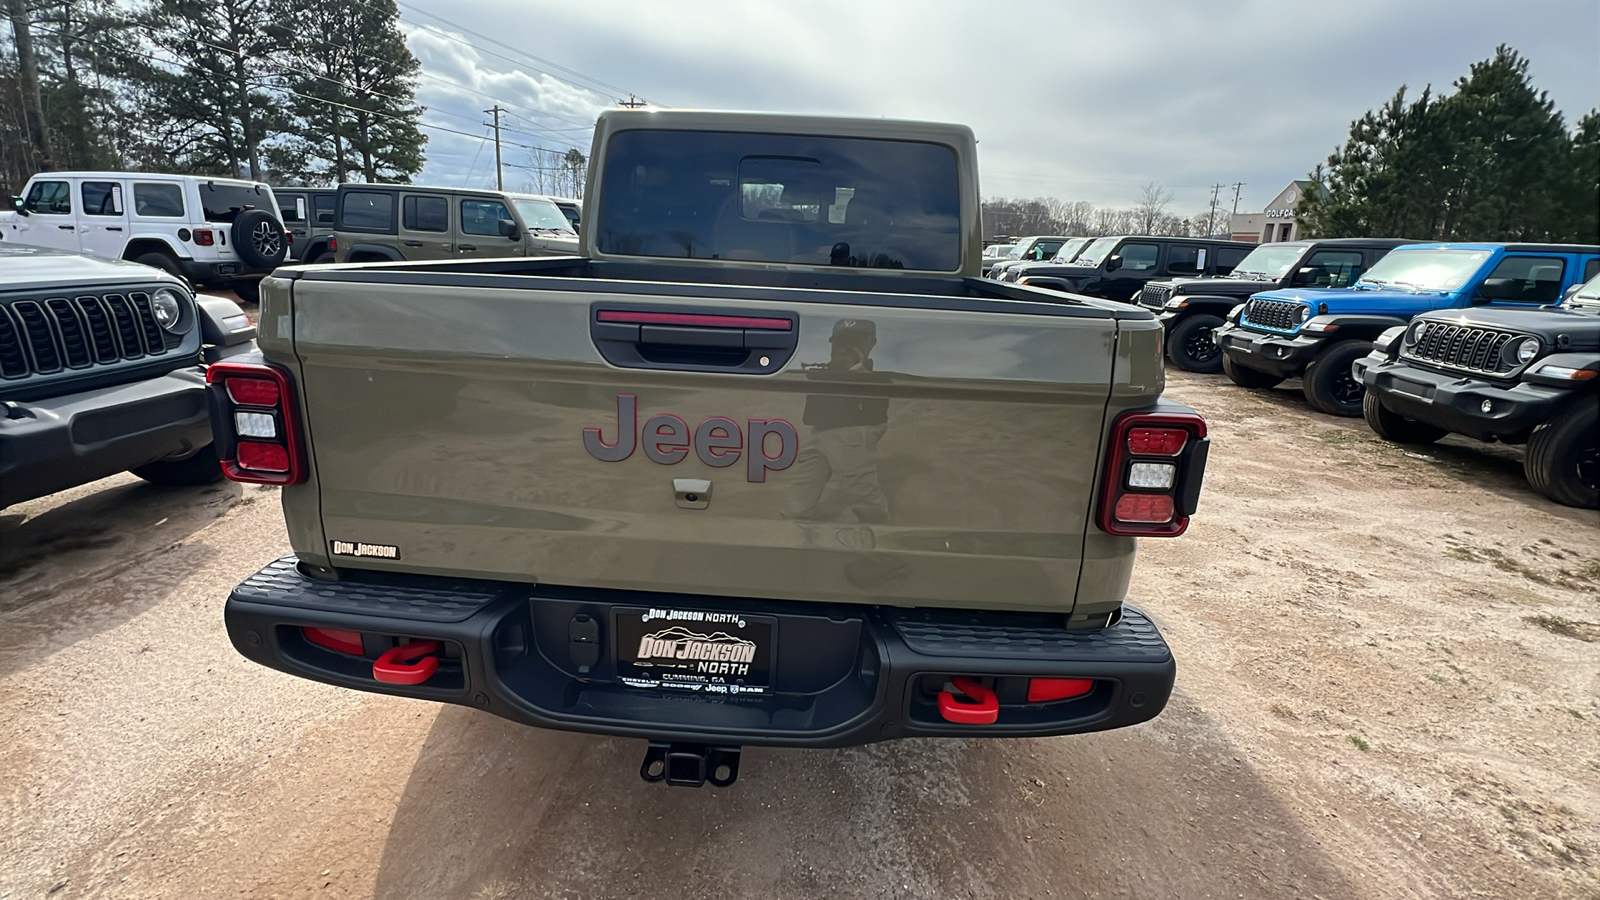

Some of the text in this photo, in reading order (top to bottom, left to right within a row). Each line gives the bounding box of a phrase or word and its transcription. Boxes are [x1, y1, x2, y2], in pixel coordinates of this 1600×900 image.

[583, 393, 798, 483] Jeep
[333, 541, 396, 558] DON JACKSON
[649, 608, 739, 623] DON JACKSON NORTH
[637, 637, 756, 663] DON JACKSON
[697, 661, 749, 675] NORTH
[705, 684, 727, 694] Jeep
